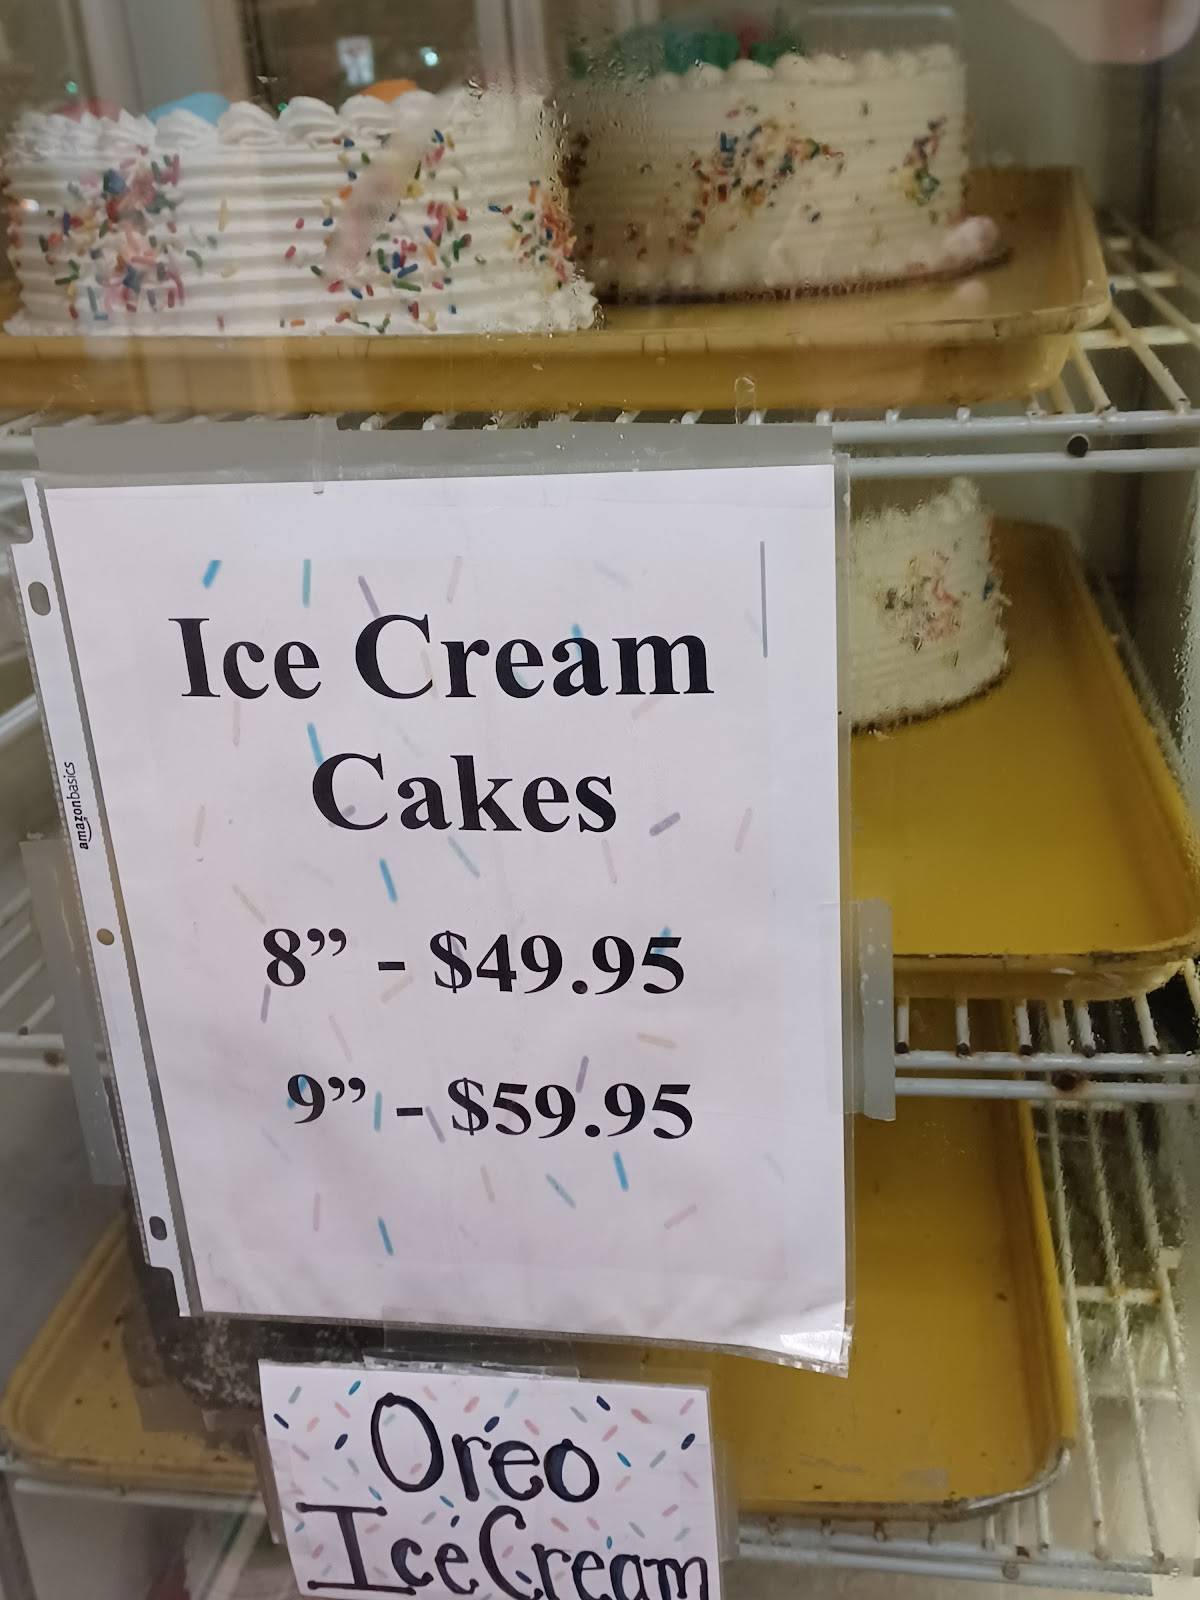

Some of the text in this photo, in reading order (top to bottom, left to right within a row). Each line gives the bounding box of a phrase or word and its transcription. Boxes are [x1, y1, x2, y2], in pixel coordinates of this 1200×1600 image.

[168, 614, 715, 700] Ice Cream
[63, 761, 91, 850] amazonbasics
[312, 752, 617, 833] Cakes
[429, 930, 685, 995] $49.95
[447, 1077, 693, 1140] $59.95
[370, 1392, 600, 1503] Oreo
